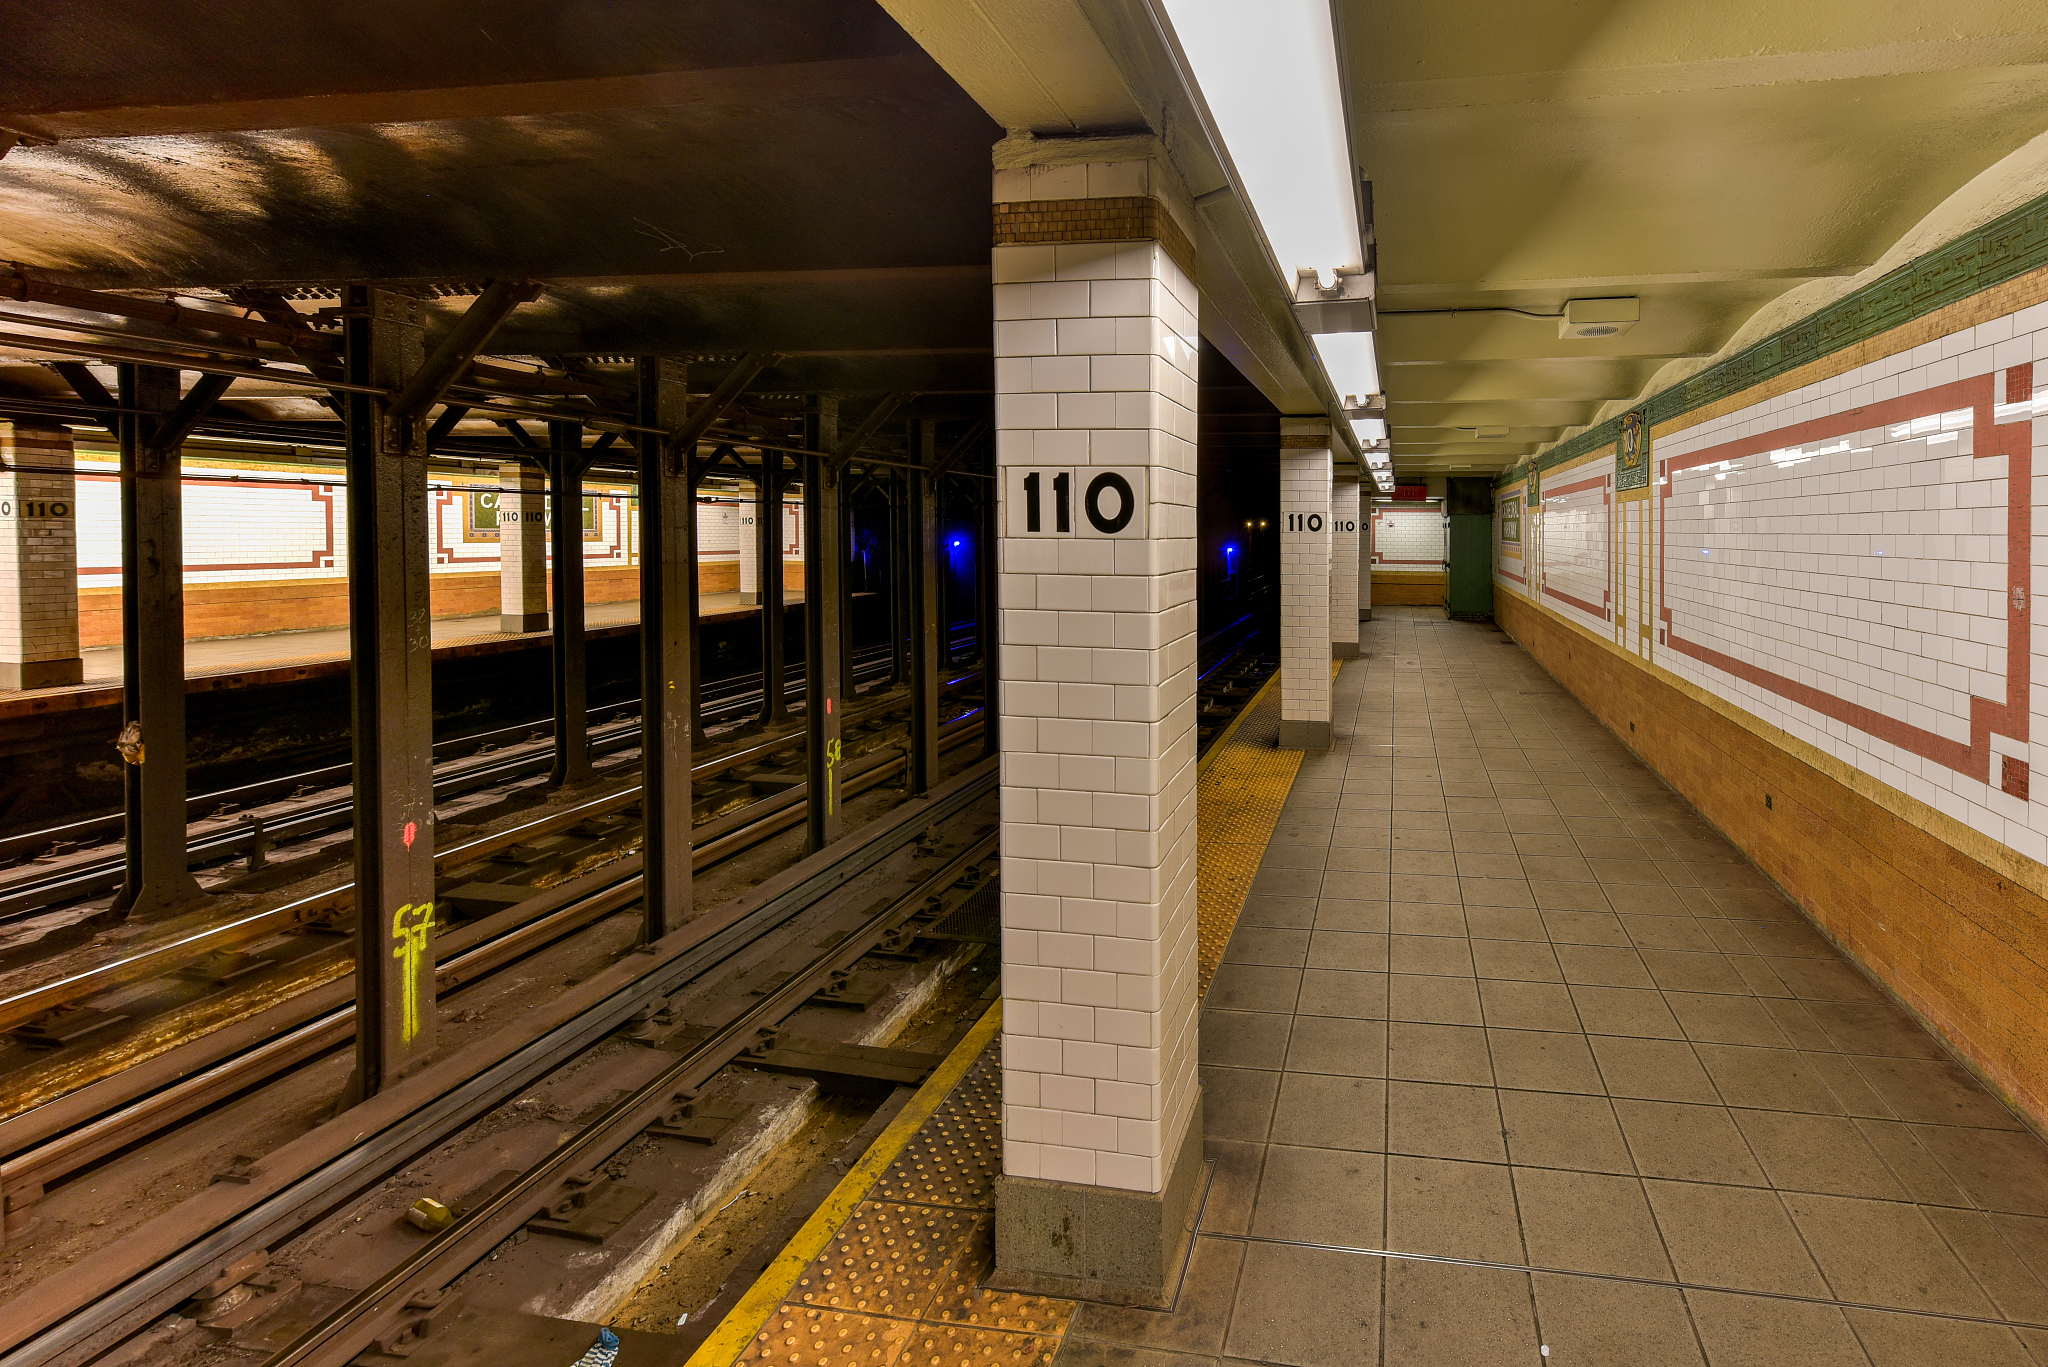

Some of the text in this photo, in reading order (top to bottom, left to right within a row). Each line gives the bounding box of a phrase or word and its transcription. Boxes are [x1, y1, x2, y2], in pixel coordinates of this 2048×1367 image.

[27, 502, 68, 516] 110
[1024, 472, 1134, 534] 110
[503, 512, 518, 522] 110
[525, 512, 543, 522] 110
[742, 517, 754, 525] 110
[1289, 514, 1322, 532] 110
[1335, 521, 1354, 532] 110
[826, 737, 841, 768] 58
[393, 902, 435, 957] 57
